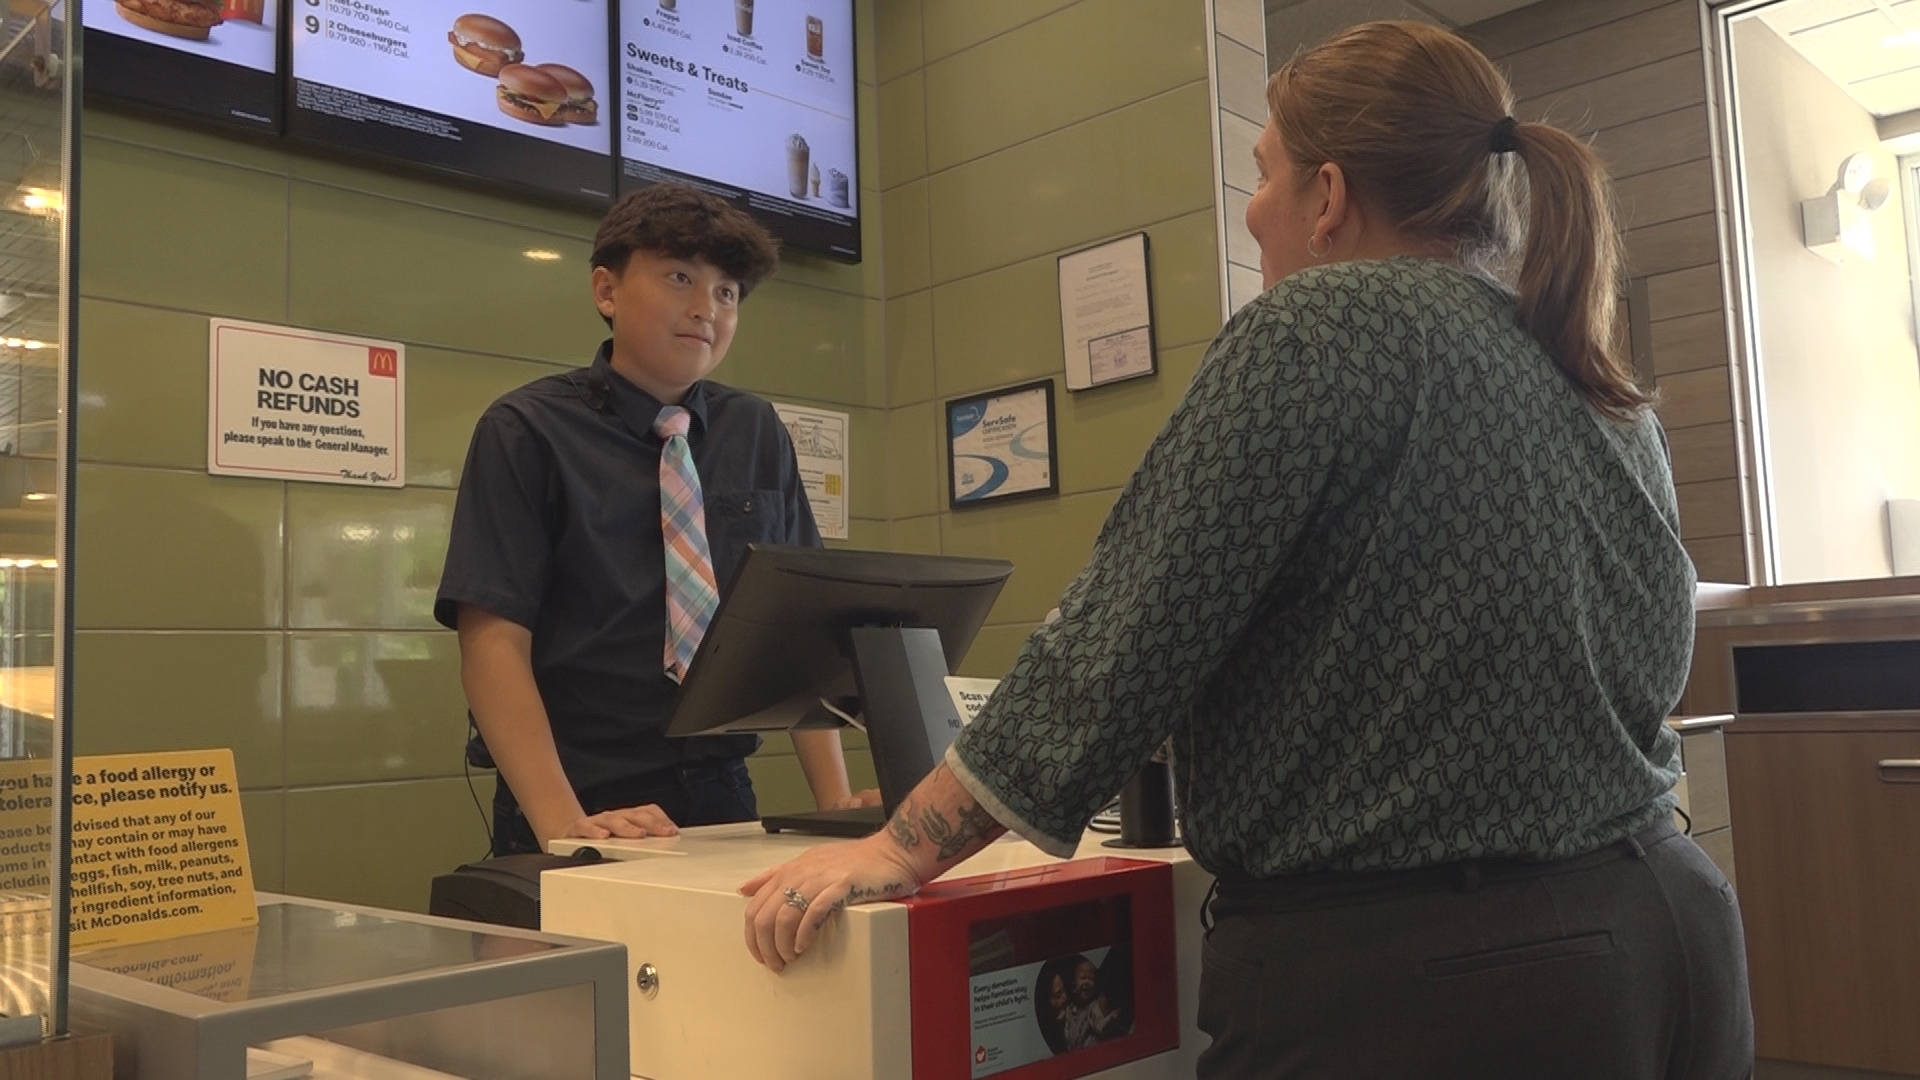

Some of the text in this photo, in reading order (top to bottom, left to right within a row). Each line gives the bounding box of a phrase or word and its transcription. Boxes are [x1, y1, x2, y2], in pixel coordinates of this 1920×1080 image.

[305, 14, 320, 34] 9
[329, 4, 351, 16] 10.79
[353, 8, 370, 22] 700
[329, 20, 407, 48] 2 Cheeseburgers
[329, 30, 347, 42] 9.79
[349, 35, 366, 47] 920
[626, 42, 684, 73] Sweets
[687, 62, 699, 78] &
[702, 66, 749, 93] Treats
[259, 368, 359, 397] NO CASH
[257, 391, 360, 418] REFUNDS
[251, 416, 365, 439] If you have any questions,
[224, 430, 389, 457] please speak to the General Manager.
[340, 469, 392, 484] Thank You!
[959, 691, 984, 701] Scan
[965, 703, 982, 712] cod
[86, 773, 97, 785] a
[99, 767, 138, 784] food
[142, 766, 196, 781] allergy
[200, 766, 215, 777] or
[101, 788, 156, 807] please
[160, 782, 207, 800] notify
[210, 783, 232, 795] us.
[0, 827, 33, 839] ease
[73, 817, 120, 832] dvised
[123, 815, 151, 828] that
[154, 814, 176, 826] any
[180, 809, 192, 822] of
[195, 810, 216, 820] our
[1, 841, 52, 856] oducts
[97, 830, 149, 846] contain
[152, 830, 165, 840] or
[168, 828, 195, 840] may
[197, 824, 227, 836] have
[32, 857, 47, 869] in
[72, 850, 112, 865] ntact
[115, 847, 145, 860] with
[148, 843, 178, 856] food
[181, 838, 239, 853] allergens
[70, 869, 110, 884] eggs,
[112, 863, 142, 876] fish,
[144, 859, 177, 872] milk,
[179, 854, 234, 871] peanuts,
[70, 866, 243, 898] hellfish, soy, tree nuts, and
[81, 894, 154, 914] ingredient
[157, 884, 236, 903] information,
[91, 905, 203, 928] McDonalds.com.
[973, 978, 1018, 994] Every donation
[974, 986, 1028, 1003] helps families stay
[980, 1001, 994, 1011] their
